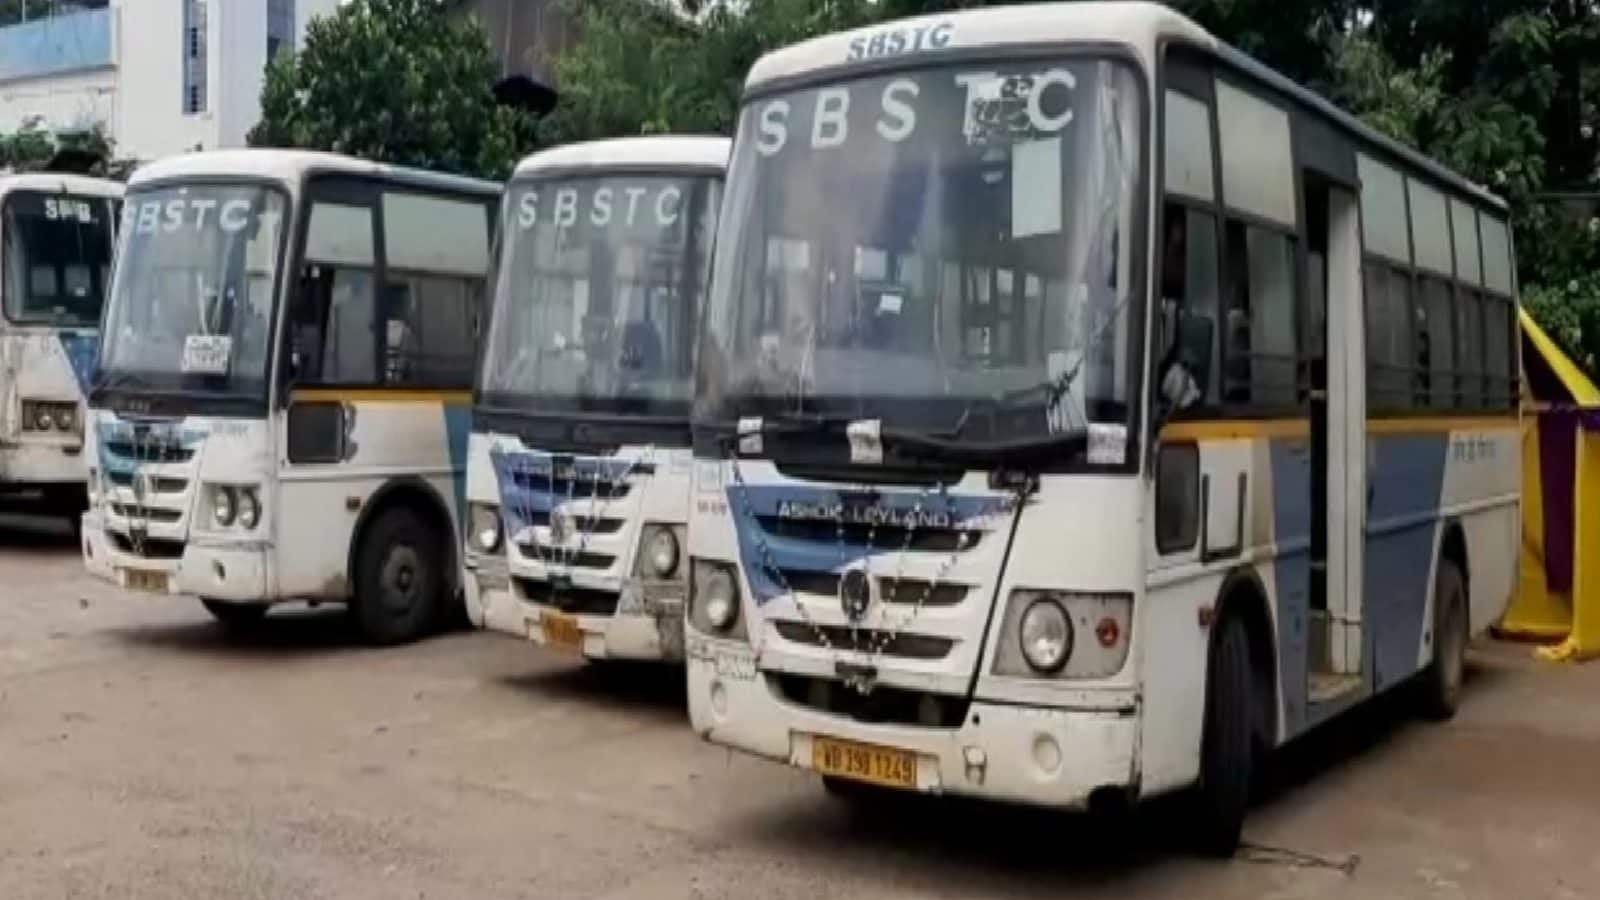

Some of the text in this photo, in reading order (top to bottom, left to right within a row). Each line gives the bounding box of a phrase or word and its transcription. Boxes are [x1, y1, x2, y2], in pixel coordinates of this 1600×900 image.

[848, 24, 954, 61] SBSTC
[122, 199, 251, 237] SBSTC
[518, 186, 681, 228] SBSTC
